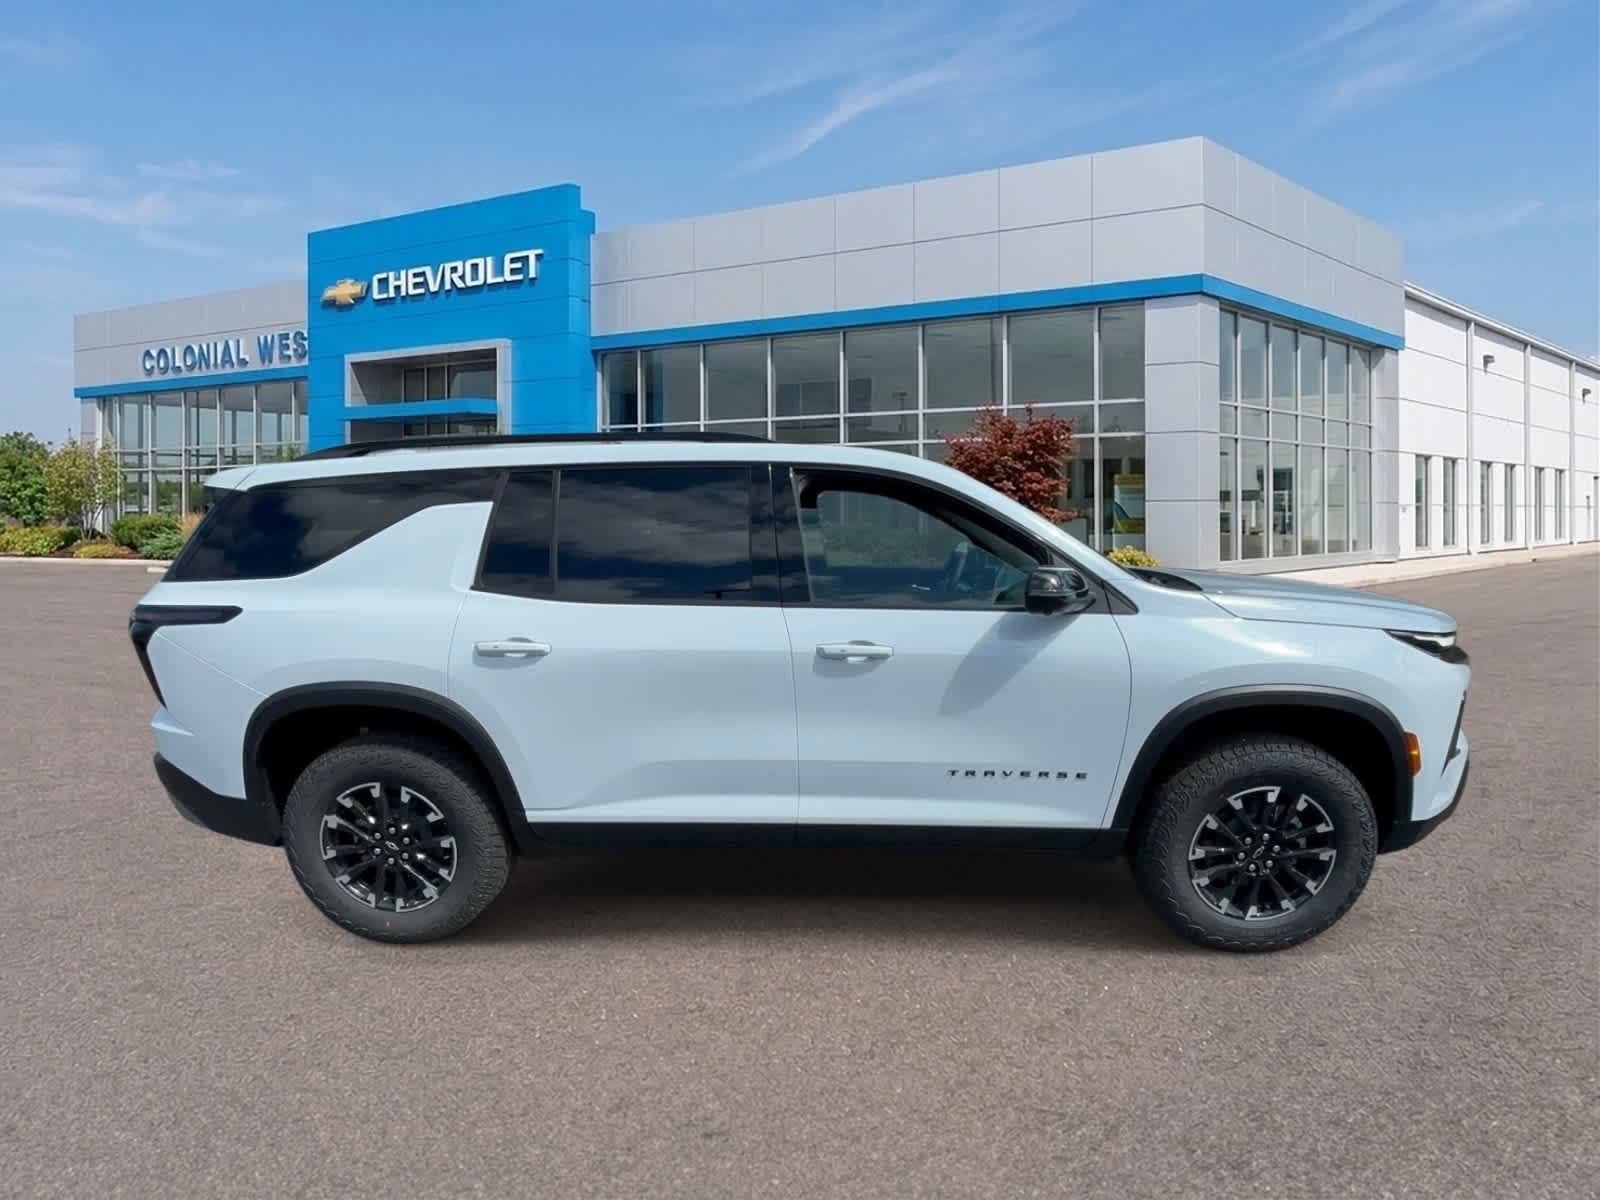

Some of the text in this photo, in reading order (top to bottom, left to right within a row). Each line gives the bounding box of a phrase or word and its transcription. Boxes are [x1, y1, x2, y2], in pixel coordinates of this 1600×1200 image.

[371, 248, 544, 301] CHEVROLET
[142, 338, 249, 377] COLONIAL
[947, 769, 1088, 780] TRAVERSE
